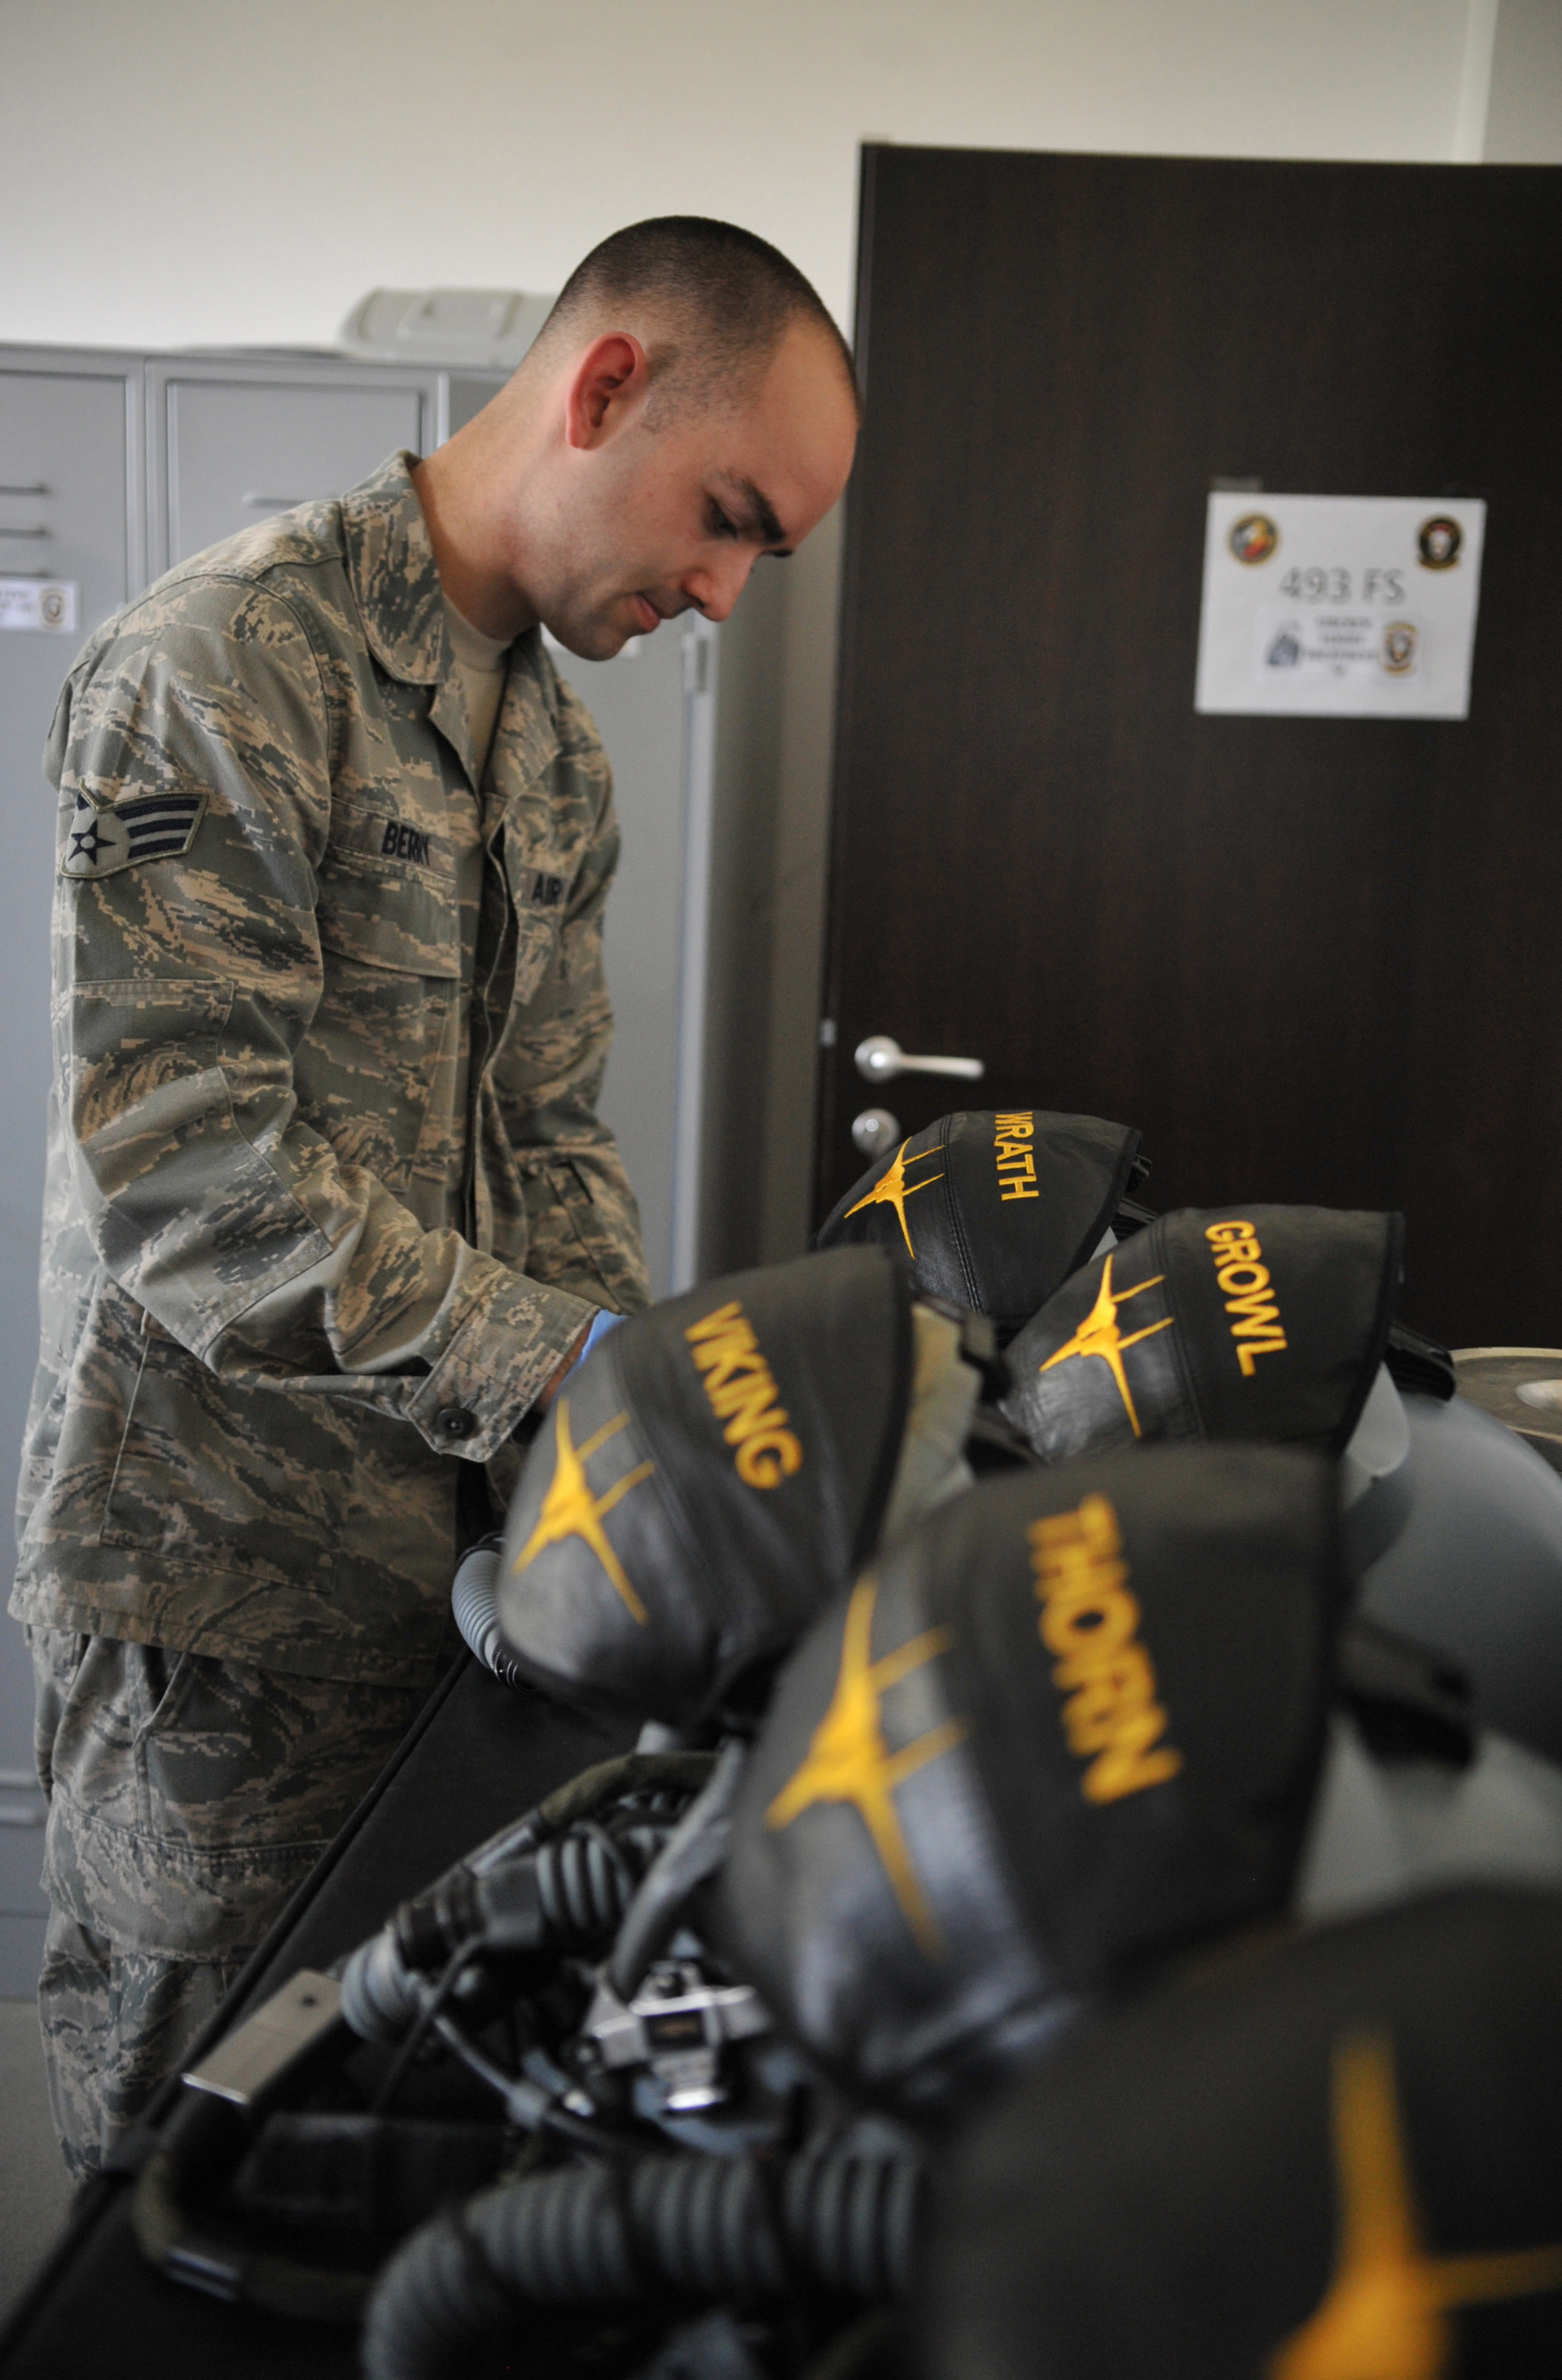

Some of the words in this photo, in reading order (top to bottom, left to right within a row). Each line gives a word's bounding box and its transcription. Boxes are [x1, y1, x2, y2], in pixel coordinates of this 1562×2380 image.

[1280, 567, 1352, 605] 493
[1362, 568, 1406, 605] FS
[381, 820, 430, 866] BERRY
[531, 873, 564, 906] AIR
[994, 1111, 1040, 1201] WRATH
[1204, 1221, 1288, 1377] GROWL
[685, 1301, 802, 1490] VIKING
[1027, 1492, 1183, 1804] THORN
